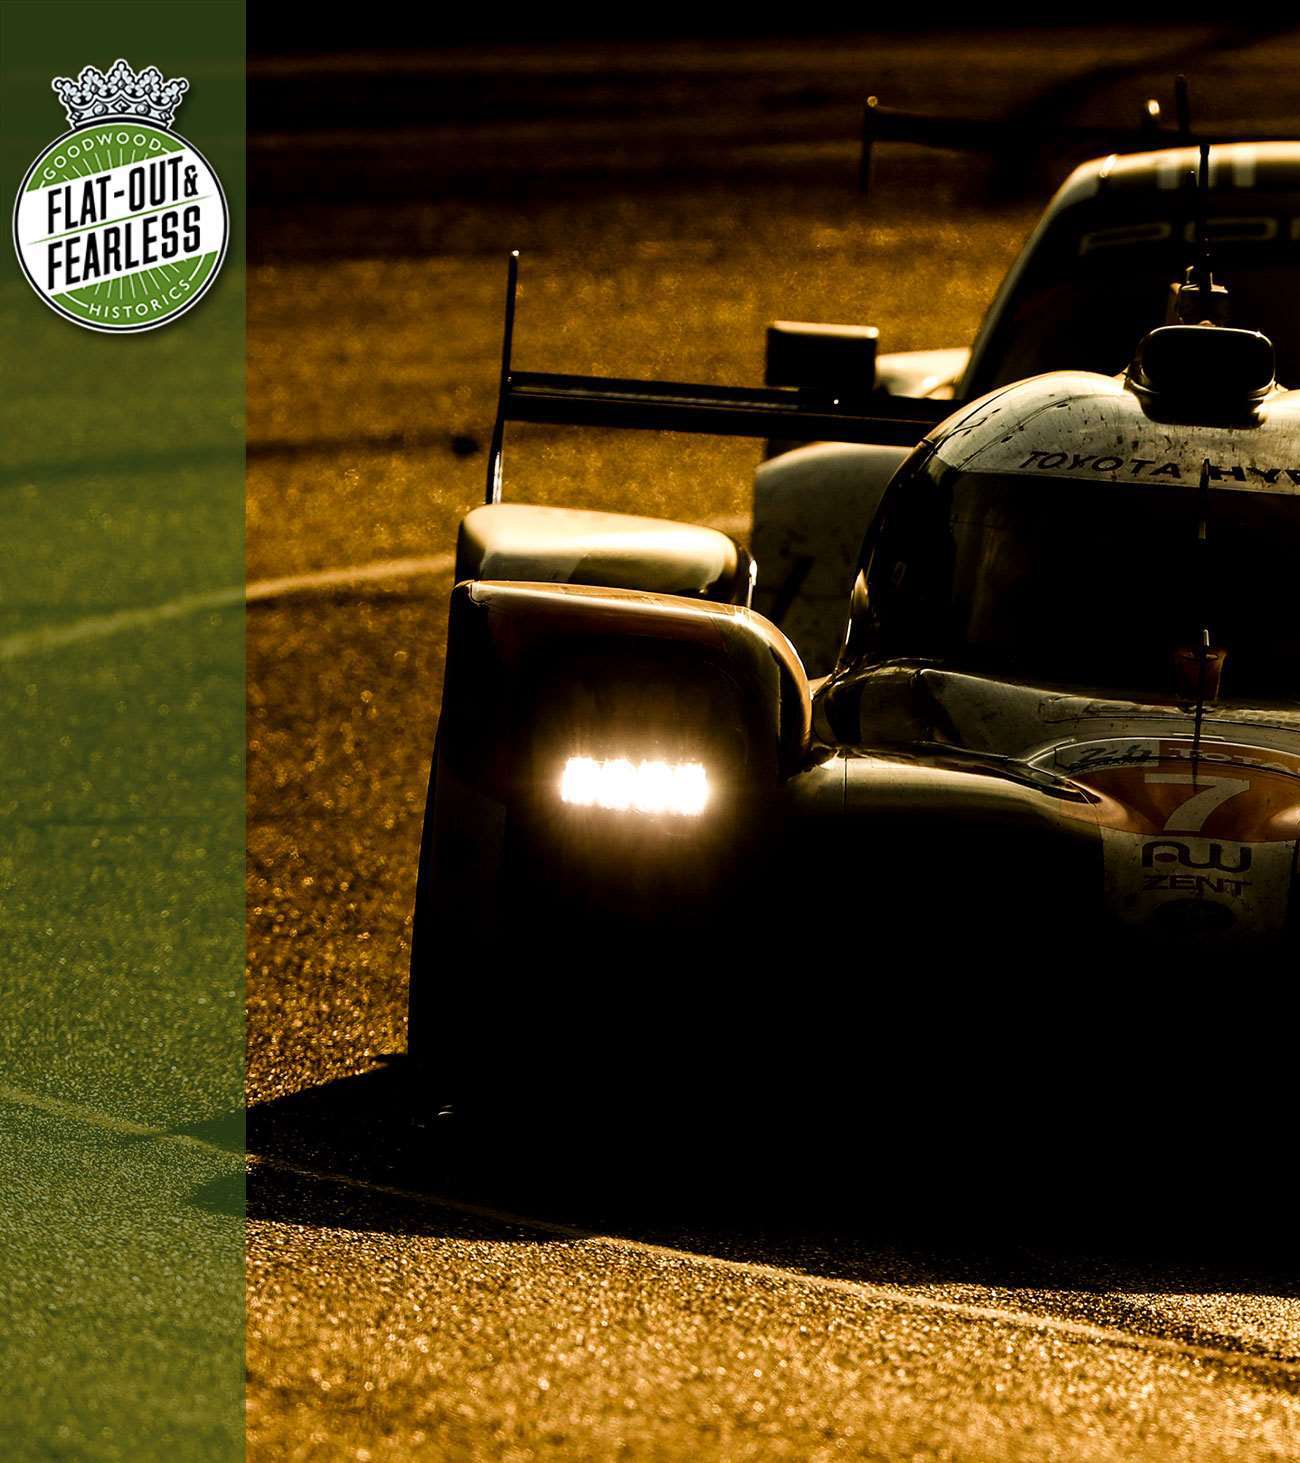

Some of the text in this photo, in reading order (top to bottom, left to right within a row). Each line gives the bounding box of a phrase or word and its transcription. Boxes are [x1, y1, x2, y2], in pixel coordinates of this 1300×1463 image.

[1019, 451, 1182, 479] TOYOTA
[1144, 773, 1251, 832] 7
[1143, 875, 1252, 897] ZENT
